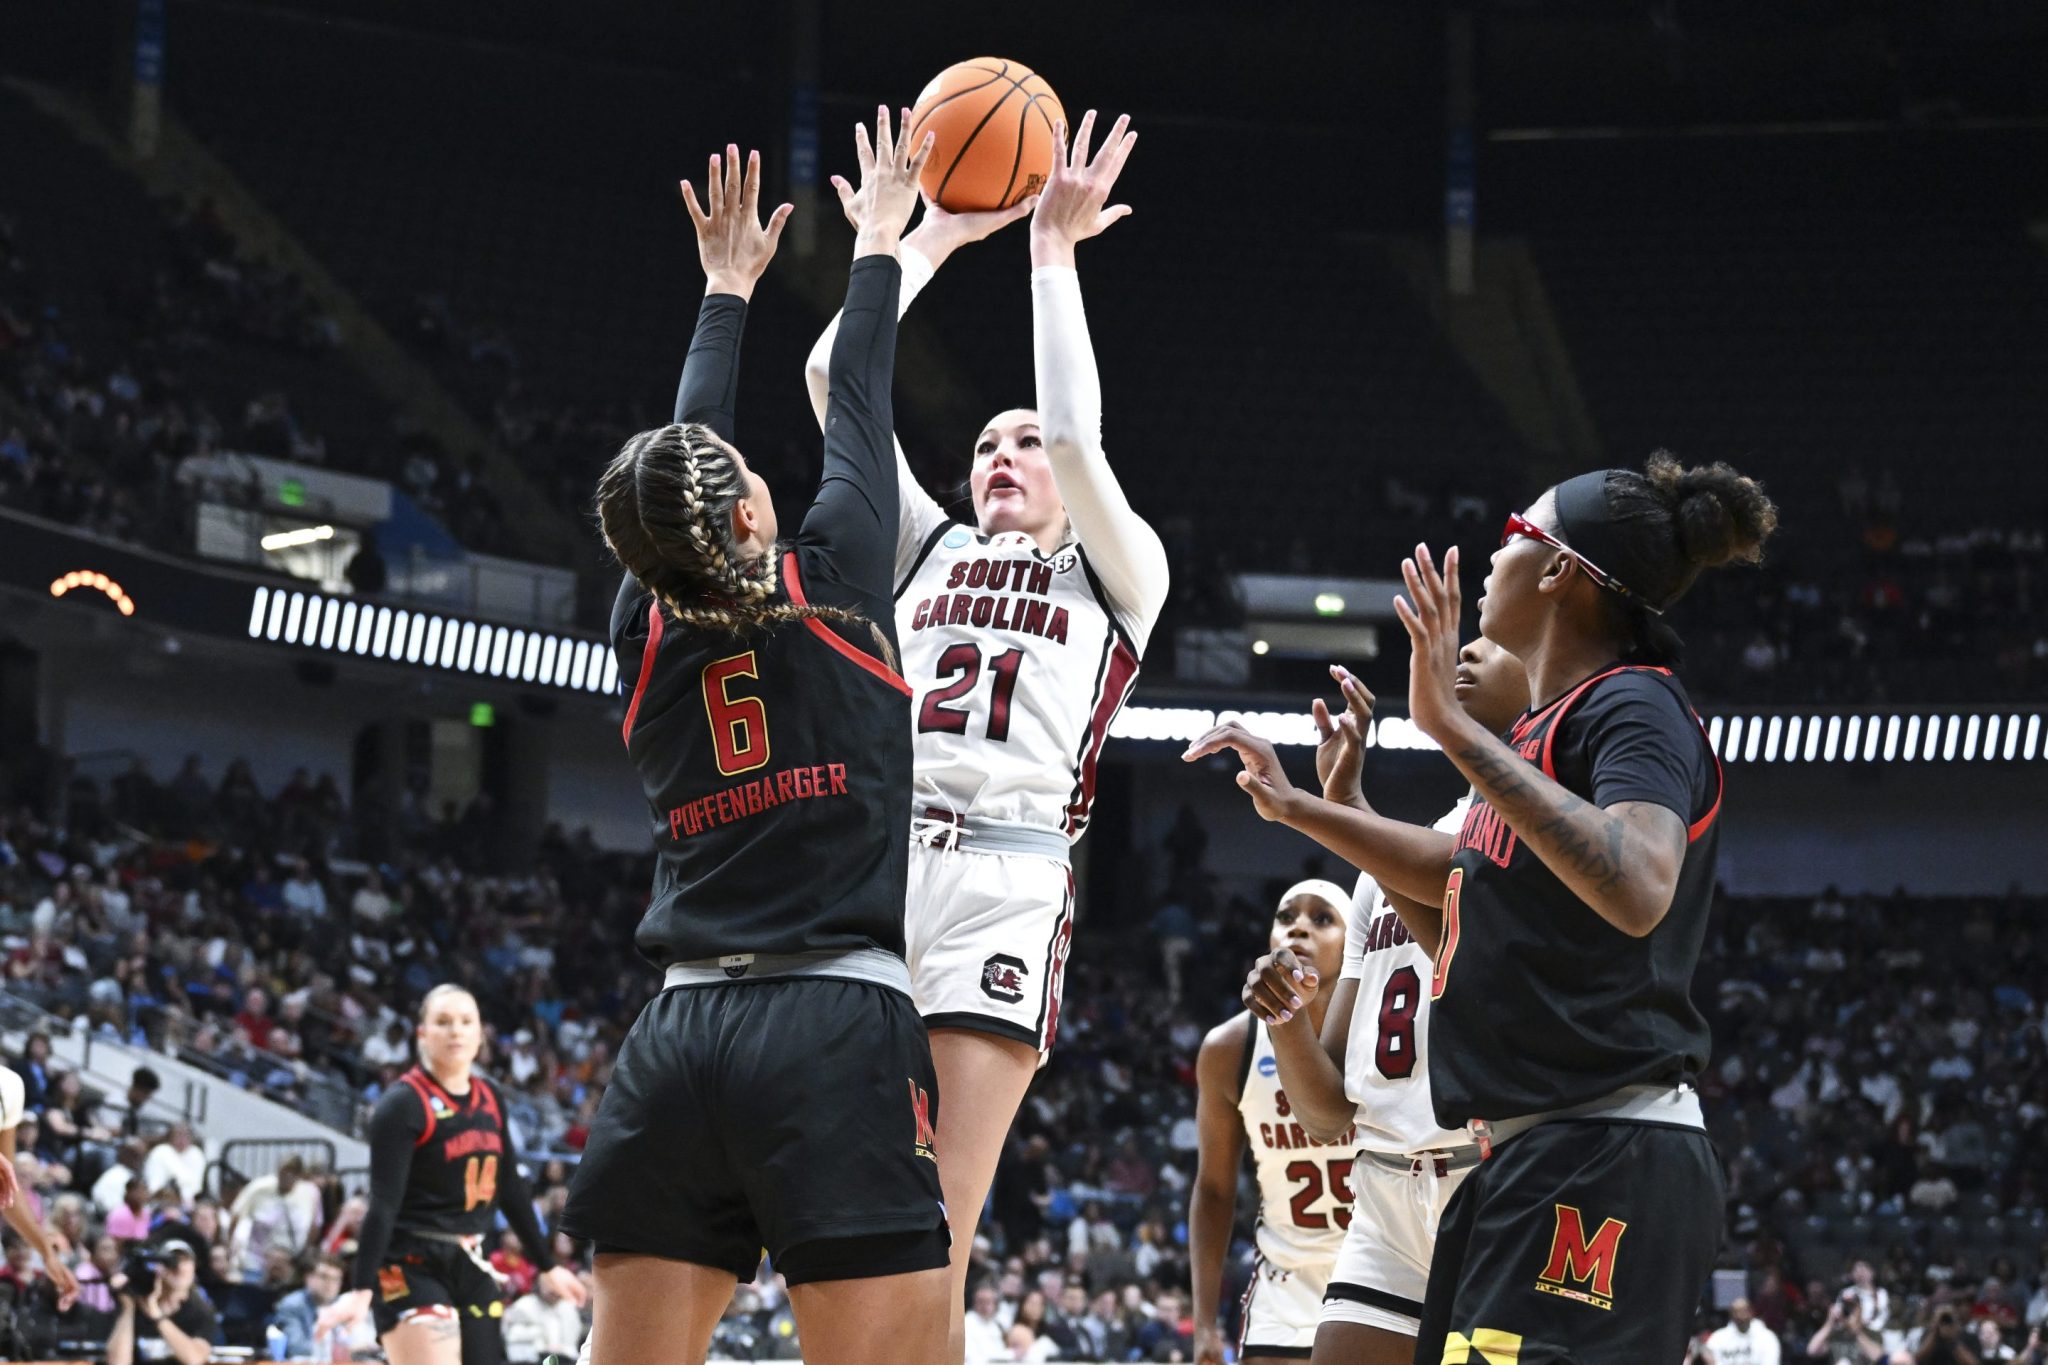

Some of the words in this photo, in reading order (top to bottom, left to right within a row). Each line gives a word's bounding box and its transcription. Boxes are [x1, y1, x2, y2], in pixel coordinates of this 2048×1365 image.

[911, 594, 1069, 646] CAROLINA
[946, 558, 1053, 596] SOUTH
[701, 650, 771, 777] 6
[917, 643, 1025, 743] 21
[669, 763, 849, 841] POFFENBARGER
[1375, 965, 1421, 1080] 8
[1285, 1158, 1356, 1231] 25
[1538, 1203, 1628, 1299] M
